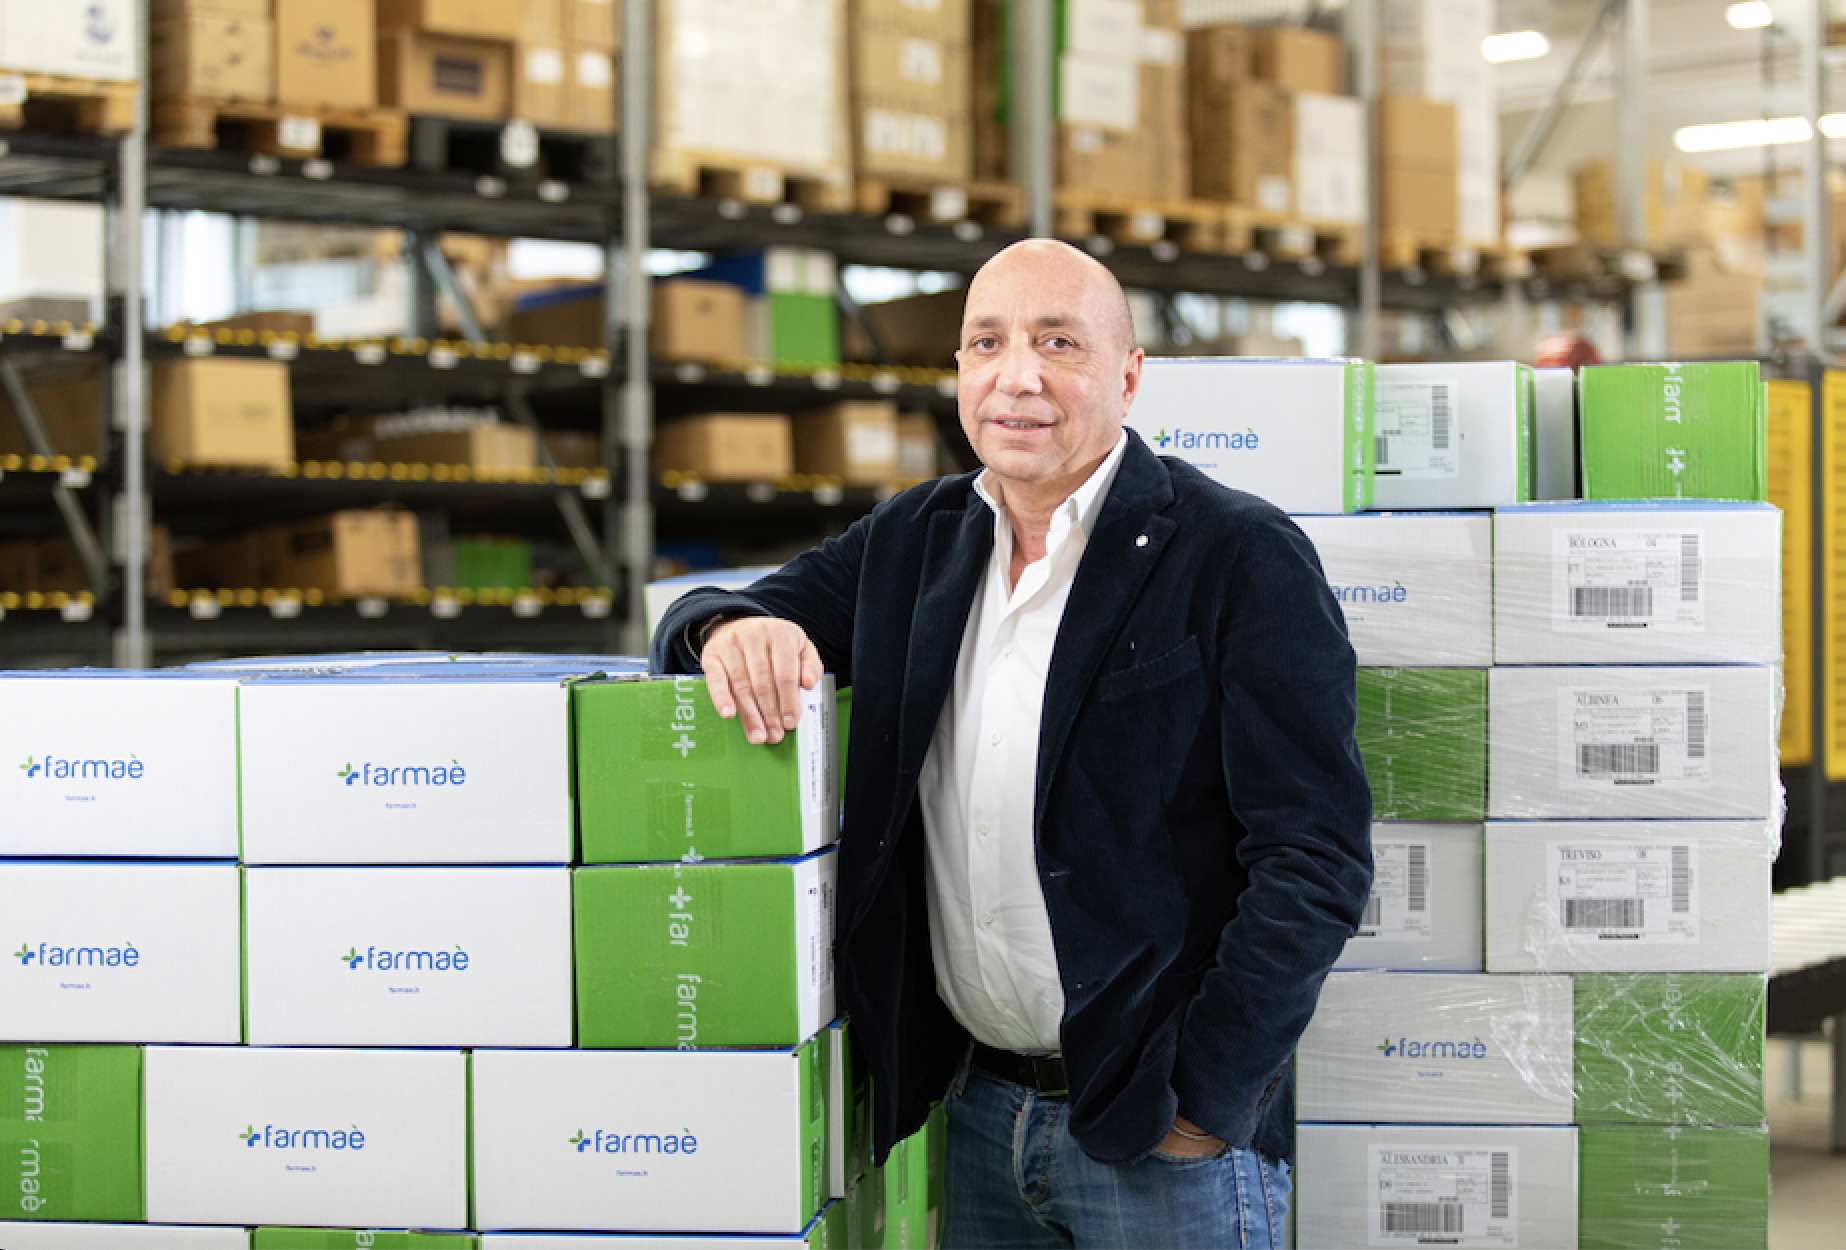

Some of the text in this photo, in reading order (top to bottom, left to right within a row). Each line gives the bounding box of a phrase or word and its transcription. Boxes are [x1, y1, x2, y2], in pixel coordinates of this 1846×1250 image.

[1174, 427, 1259, 450] farmaè
[1569, 537, 1616, 549] BOLOGNA
[1576, 694, 1619, 706] ALBINEA
[44, 754, 145, 780] farmaè
[362, 760, 467, 786] farmaè
[1558, 849, 1602, 861] TREVISO
[38, 940, 140, 967] farmaè
[367, 944, 469, 971] farmaè
[1398, 1036, 1487, 1059] farmaè
[264, 1124, 366, 1150] farmaè
[594, 1128, 698, 1154] farmaè
[1380, 1154, 1448, 1166] ALESSANDRIA
